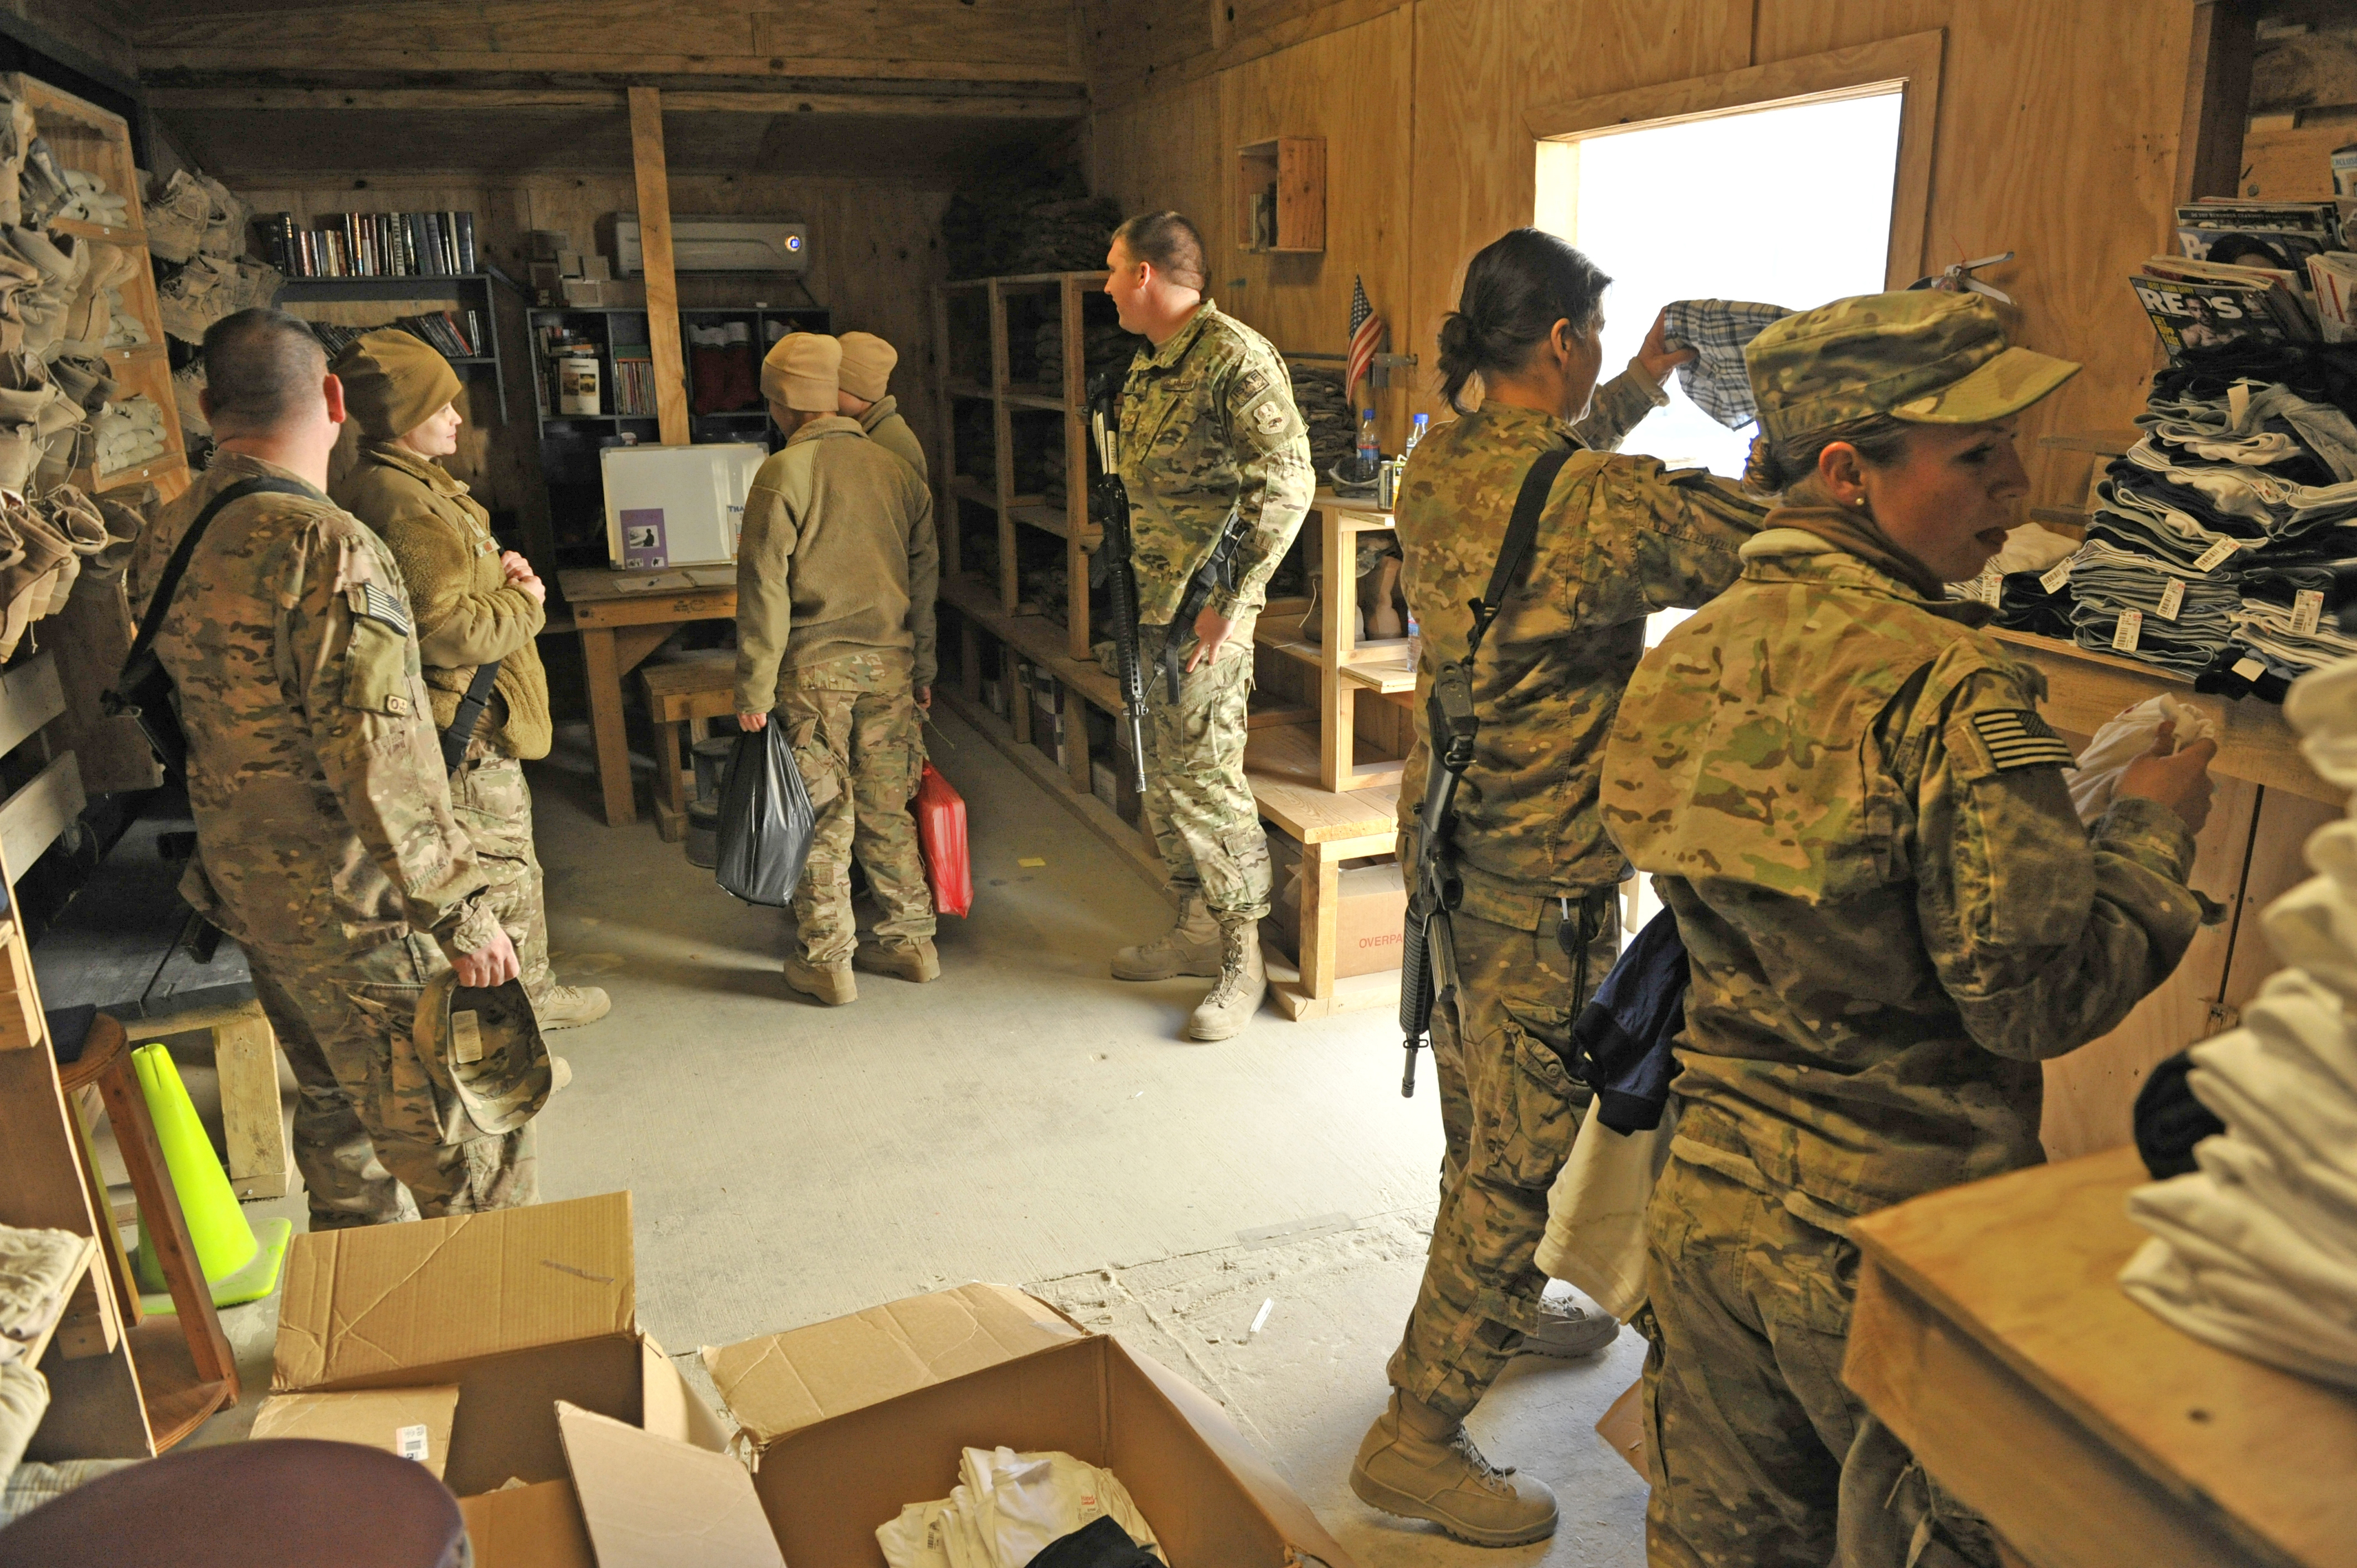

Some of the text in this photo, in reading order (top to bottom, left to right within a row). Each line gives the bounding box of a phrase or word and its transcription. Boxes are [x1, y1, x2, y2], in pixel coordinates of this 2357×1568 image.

[395, 240, 403, 267] FOLLETT
[2136, 287, 2243, 319] RES
[1233, 373, 1258, 398] ISAF
[1359, 933, 1403, 948] OVERPA
